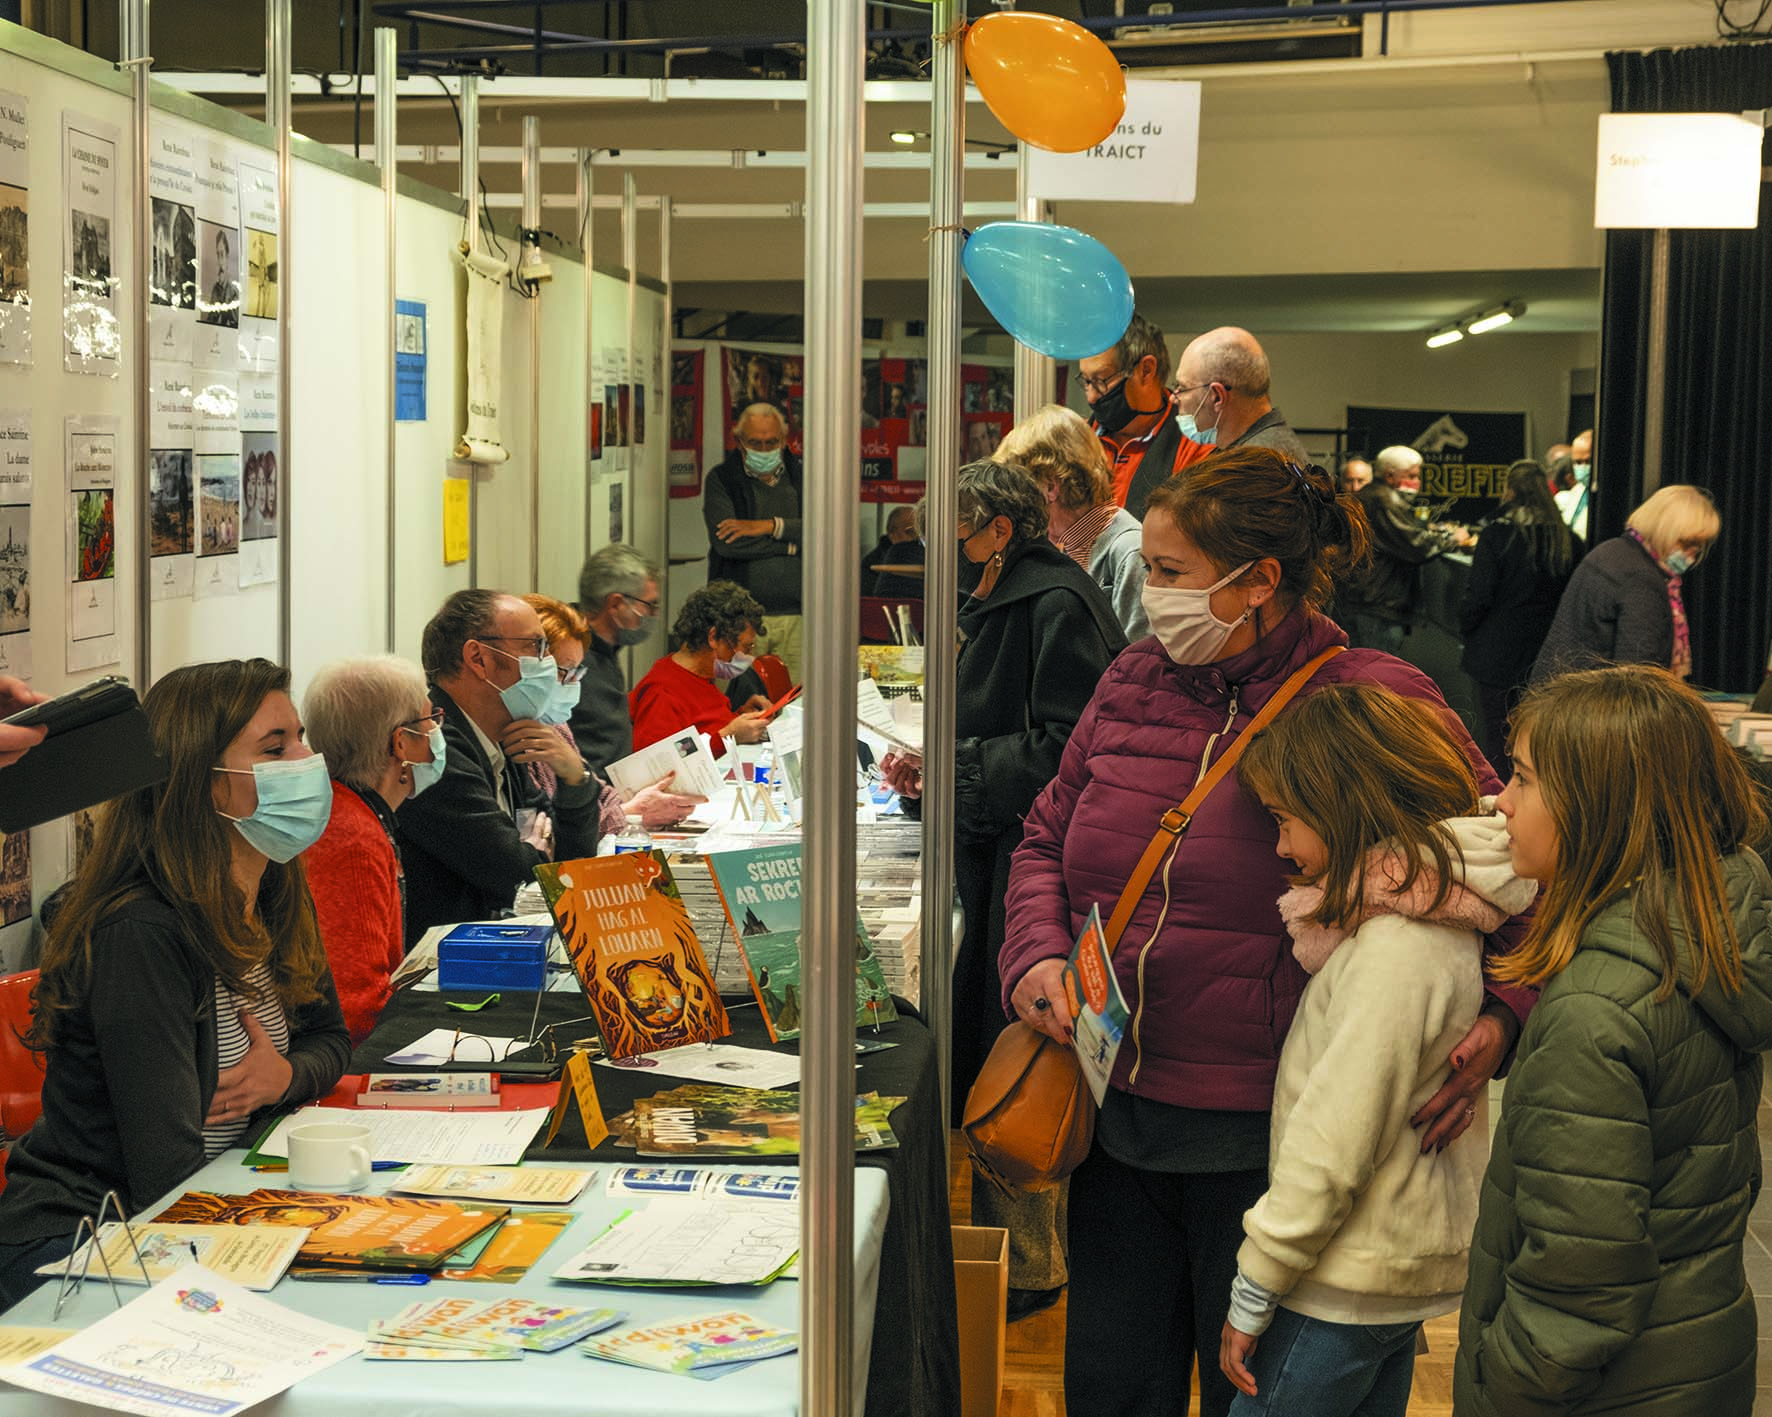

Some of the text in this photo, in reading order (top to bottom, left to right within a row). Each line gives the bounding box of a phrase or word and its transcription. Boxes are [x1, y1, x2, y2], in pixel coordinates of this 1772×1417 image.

[1141, 121, 1162, 136] du
[1420, 463, 1510, 498] REFF
[736, 886, 761, 905] AR
[596, 907, 648, 932] HAG AL
[598, 928, 664, 957] LOUARN
[652, 1107, 698, 1144] DIWAN
